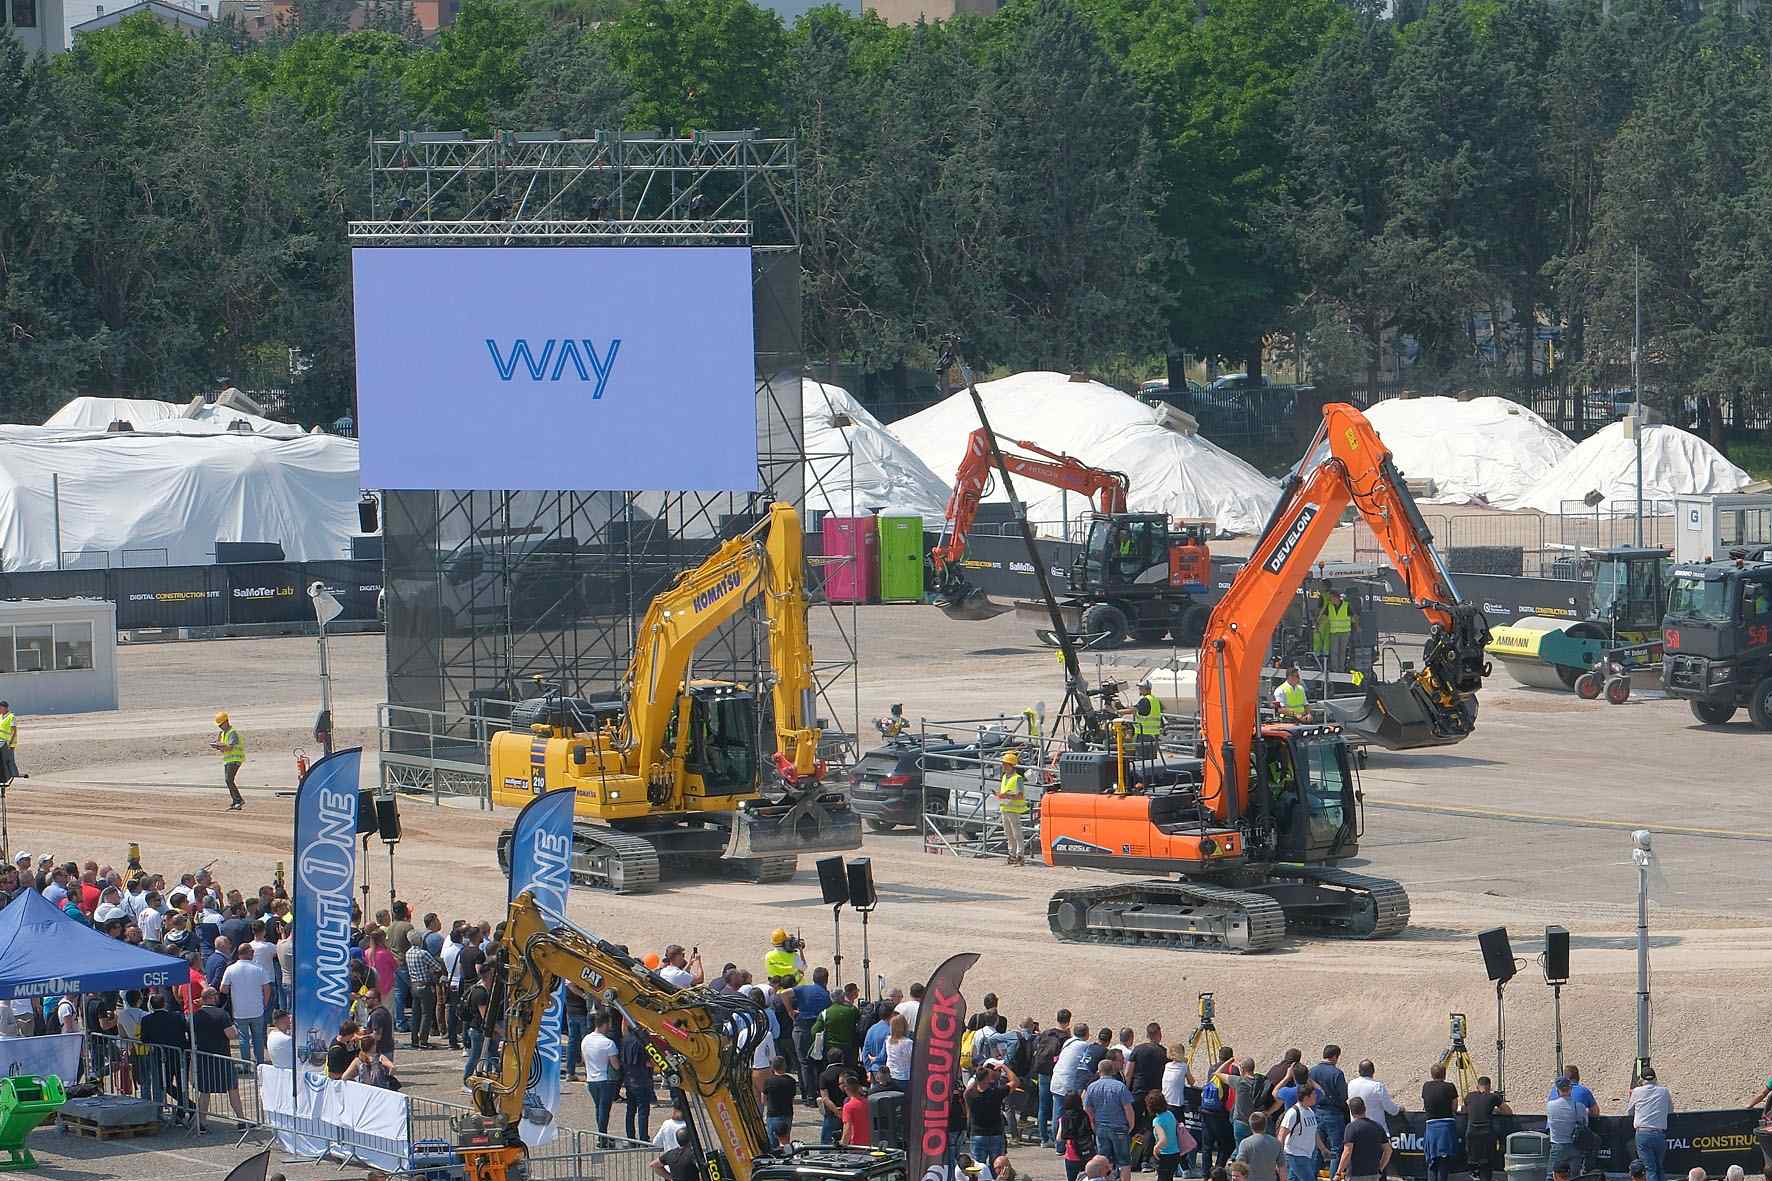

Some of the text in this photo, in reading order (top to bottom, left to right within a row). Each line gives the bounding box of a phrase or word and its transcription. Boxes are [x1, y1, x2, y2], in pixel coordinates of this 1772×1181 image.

[1271, 512, 1313, 573] DEVELON
[1010, 562, 1035, 572] SaMoTe
[130, 590, 221, 601] DIGITAL CONSTRUCTION SITE
[233, 585, 294, 598] SaMoTer Lab
[693, 570, 742, 613] KOMATSU
[1495, 636, 1529, 649] AMMANN
[143, 970, 169, 986] CSF
[580, 967, 602, 986] CAT
[645, 1042, 669, 1071] icon
[922, 989, 960, 1156] OILQUICK
